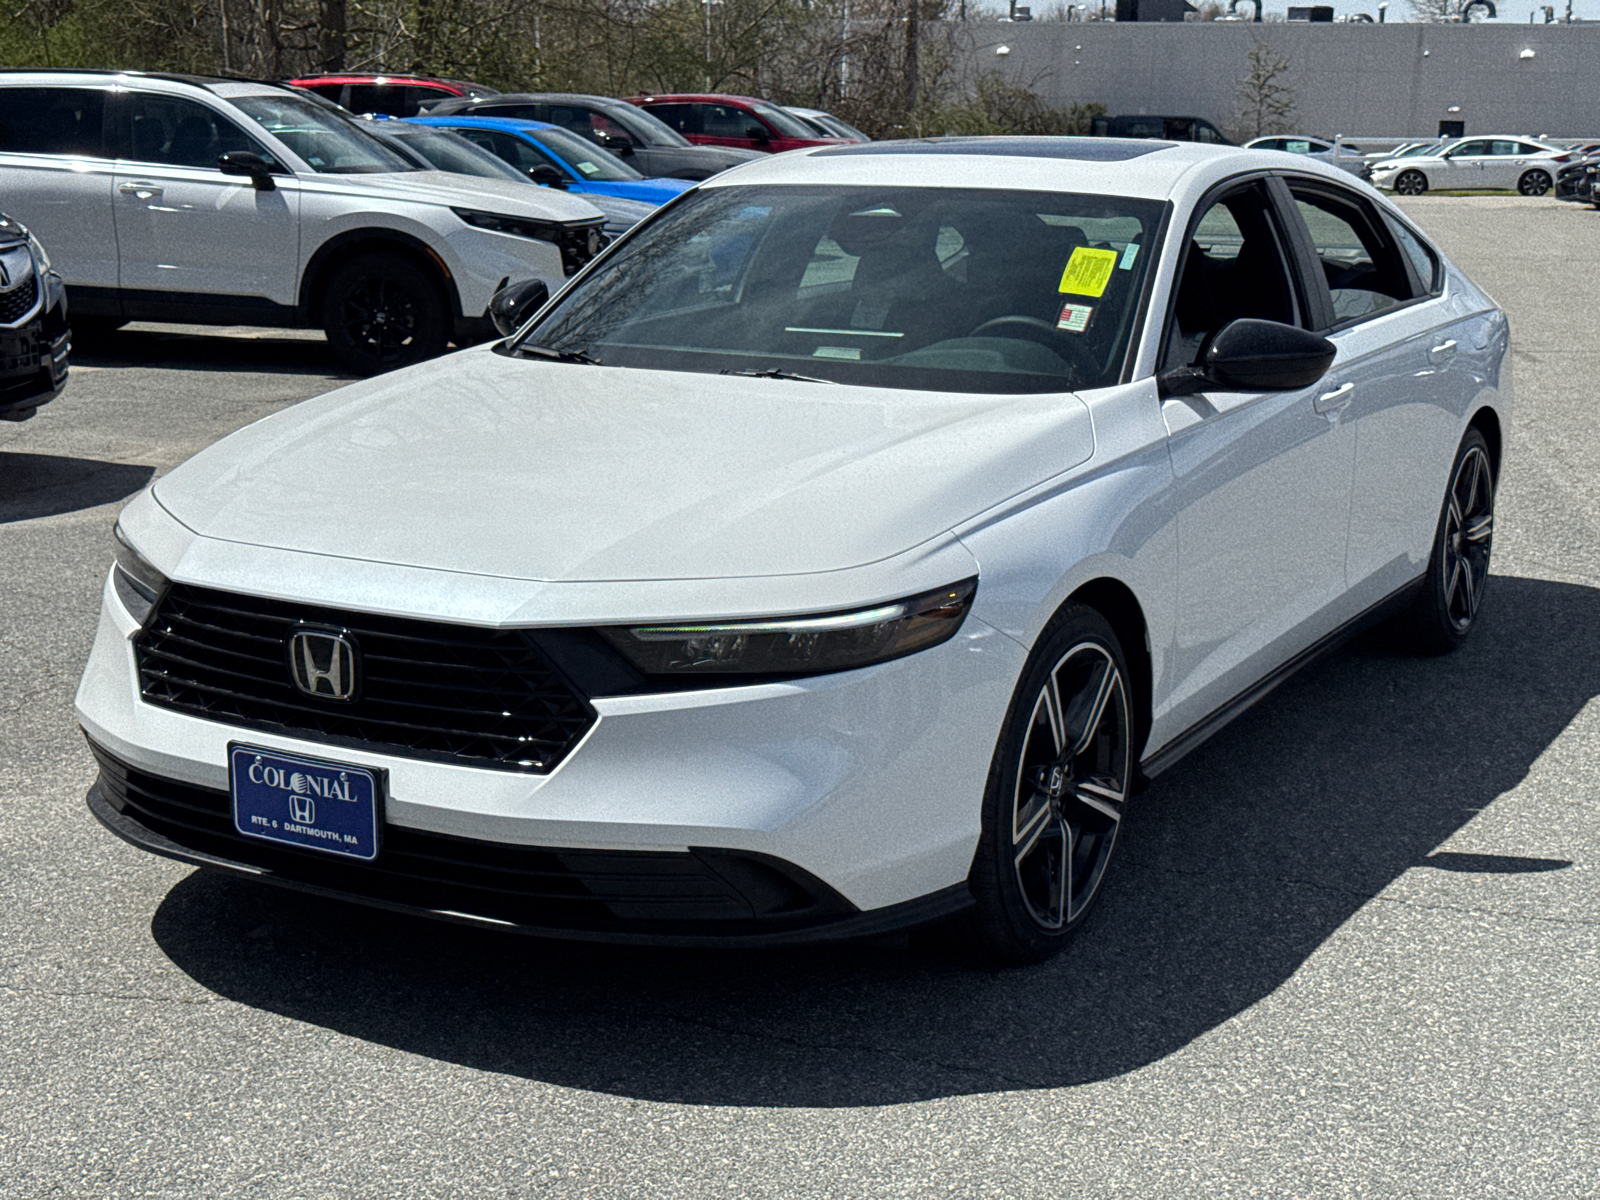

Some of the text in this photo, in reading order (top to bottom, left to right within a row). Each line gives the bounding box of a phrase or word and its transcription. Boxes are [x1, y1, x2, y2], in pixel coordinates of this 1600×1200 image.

[248, 763, 358, 802] COLONIAL
[251, 815, 358, 845] RTE. 6 DARTMOUTH, MA
